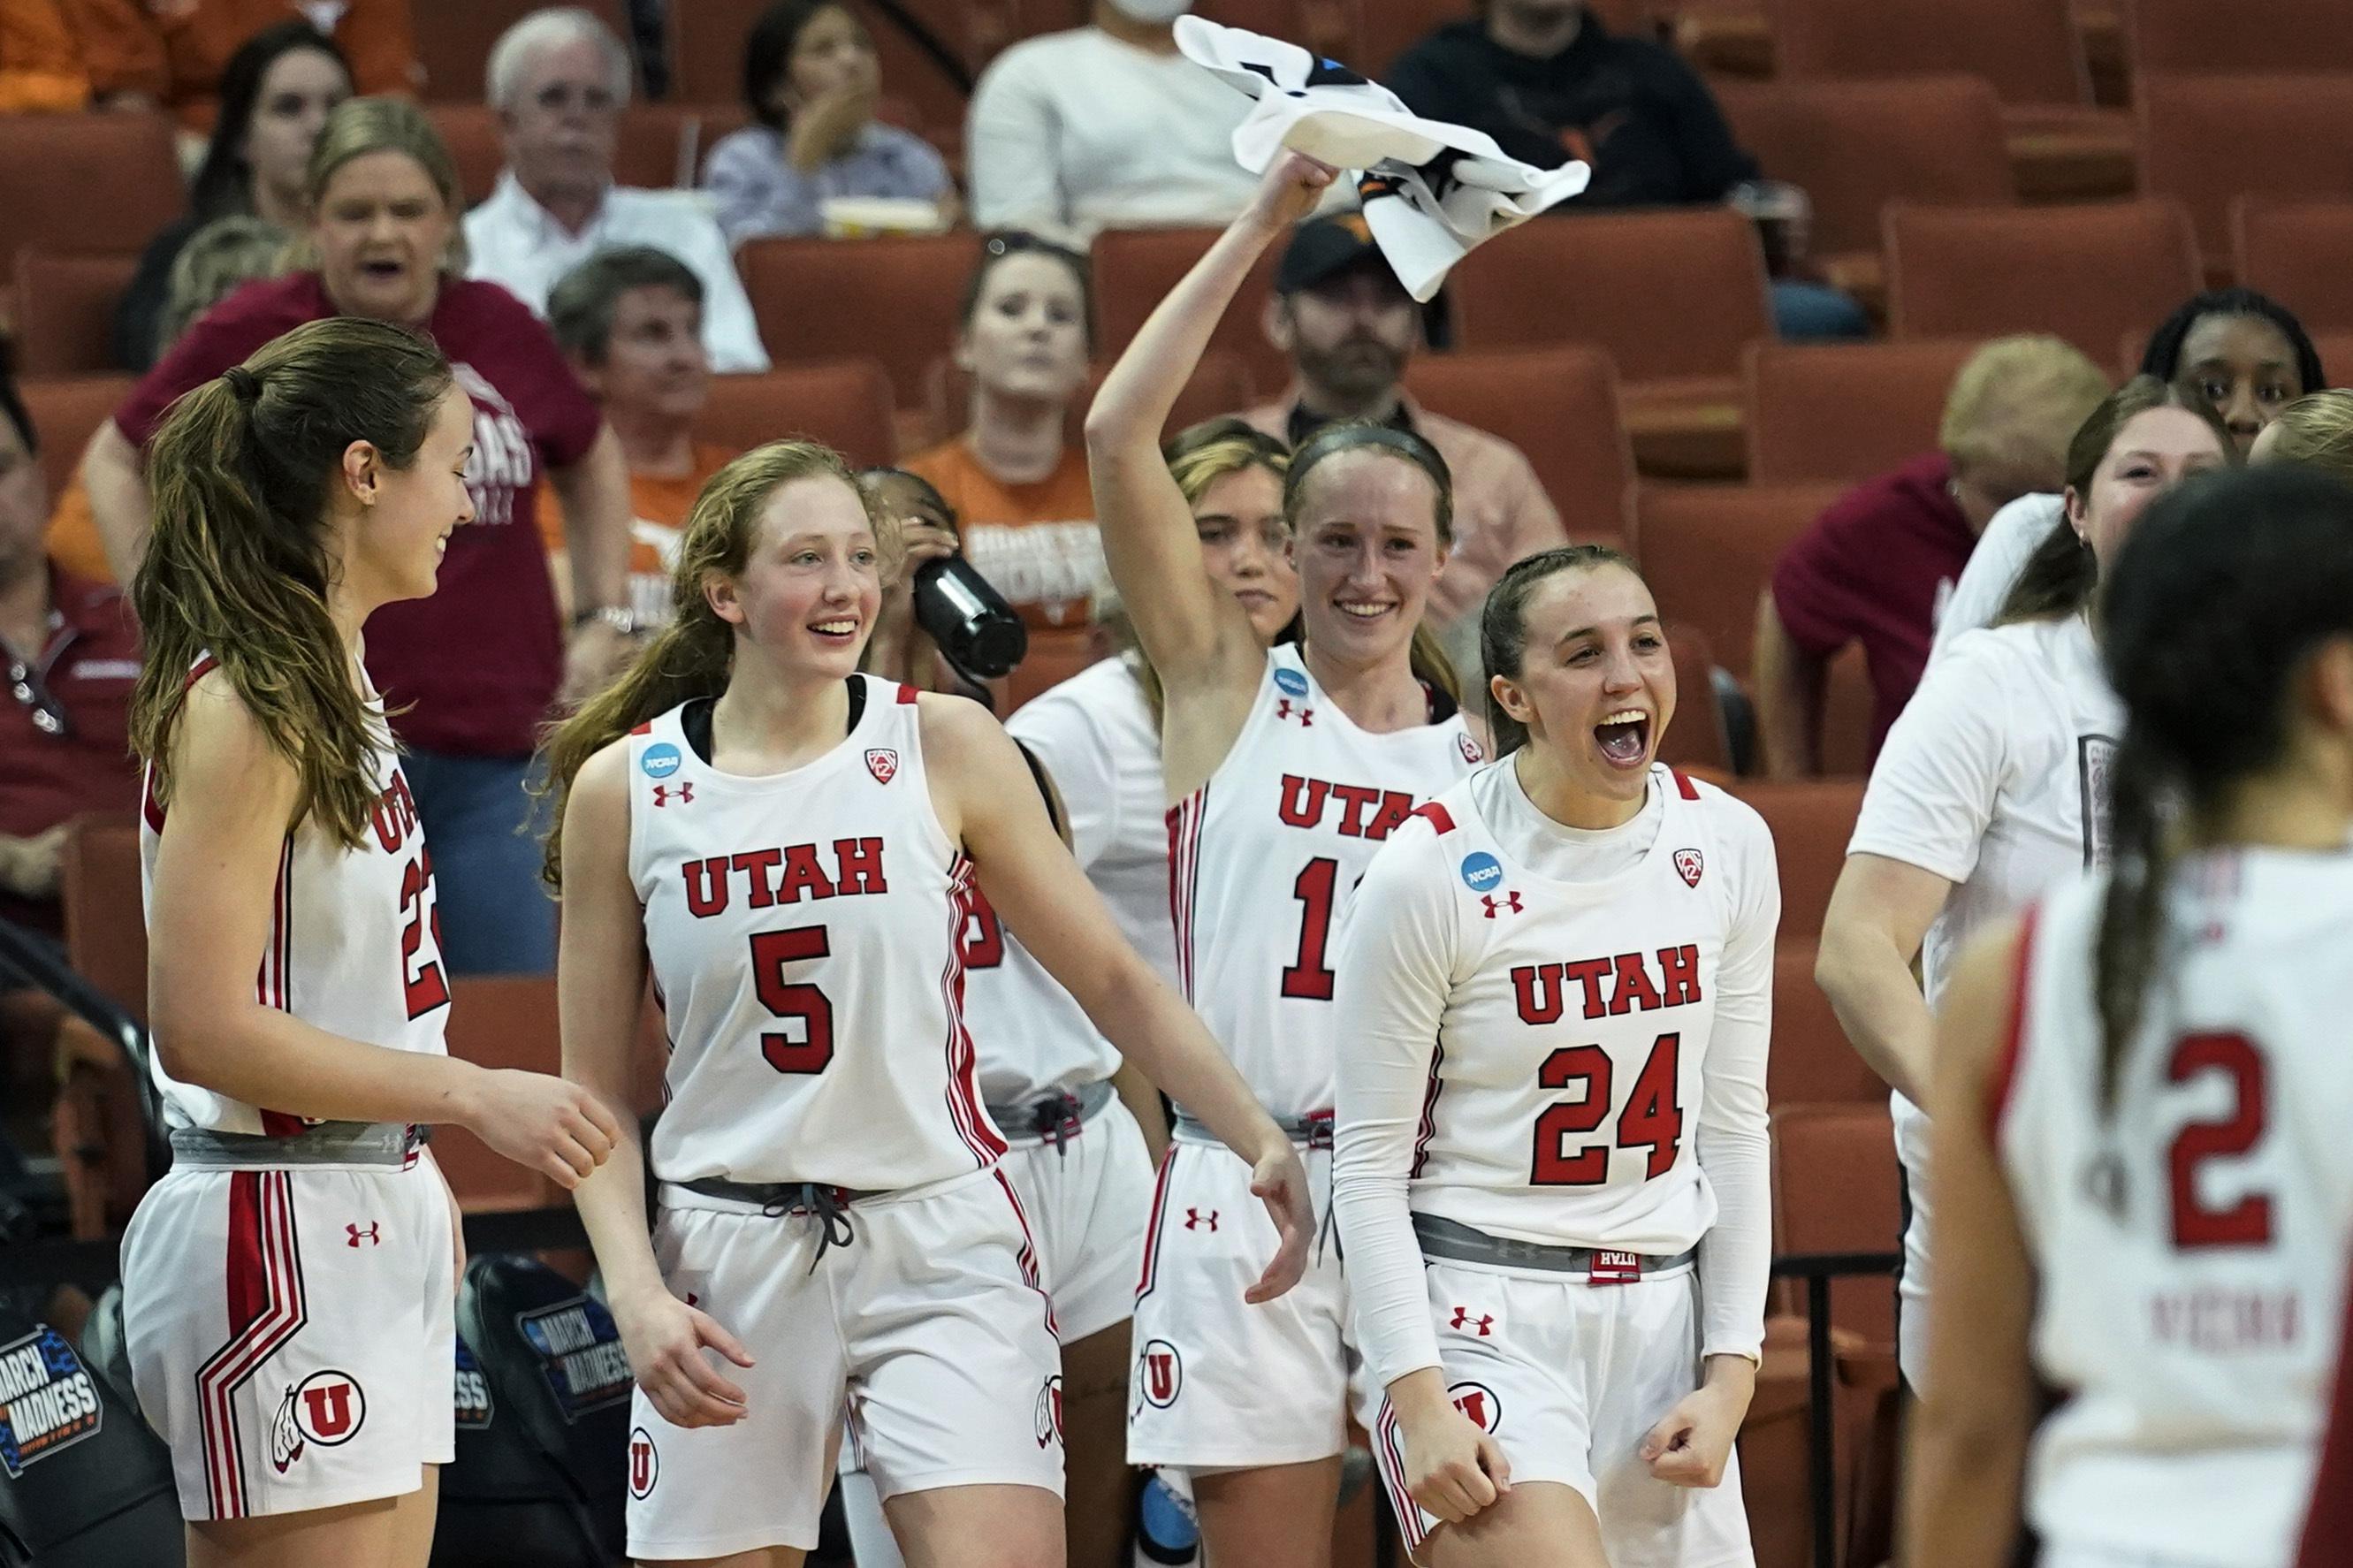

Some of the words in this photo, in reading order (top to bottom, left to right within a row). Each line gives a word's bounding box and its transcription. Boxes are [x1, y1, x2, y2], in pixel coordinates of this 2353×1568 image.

[1279, 773, 1414, 841] UTA
[682, 836, 887, 919] UTAH
[1467, 865, 1501, 884] NCAA
[1675, 850, 1702, 871] PAC
[1683, 864, 1699, 879] 12
[1280, 856, 1337, 1001] 1
[749, 924, 834, 1076] 5
[1510, 944, 1702, 1026] UTAH
[1529, 1031, 1684, 1186] 24
[2170, 1031, 2272, 1252] 2
[1601, 1251, 1637, 1267] UTAH
[7, 1372, 97, 1445] MADNESS
[304, 1383, 352, 1438] U
[1148, 1354, 1172, 1399] U
[631, 1442, 651, 1491] U
